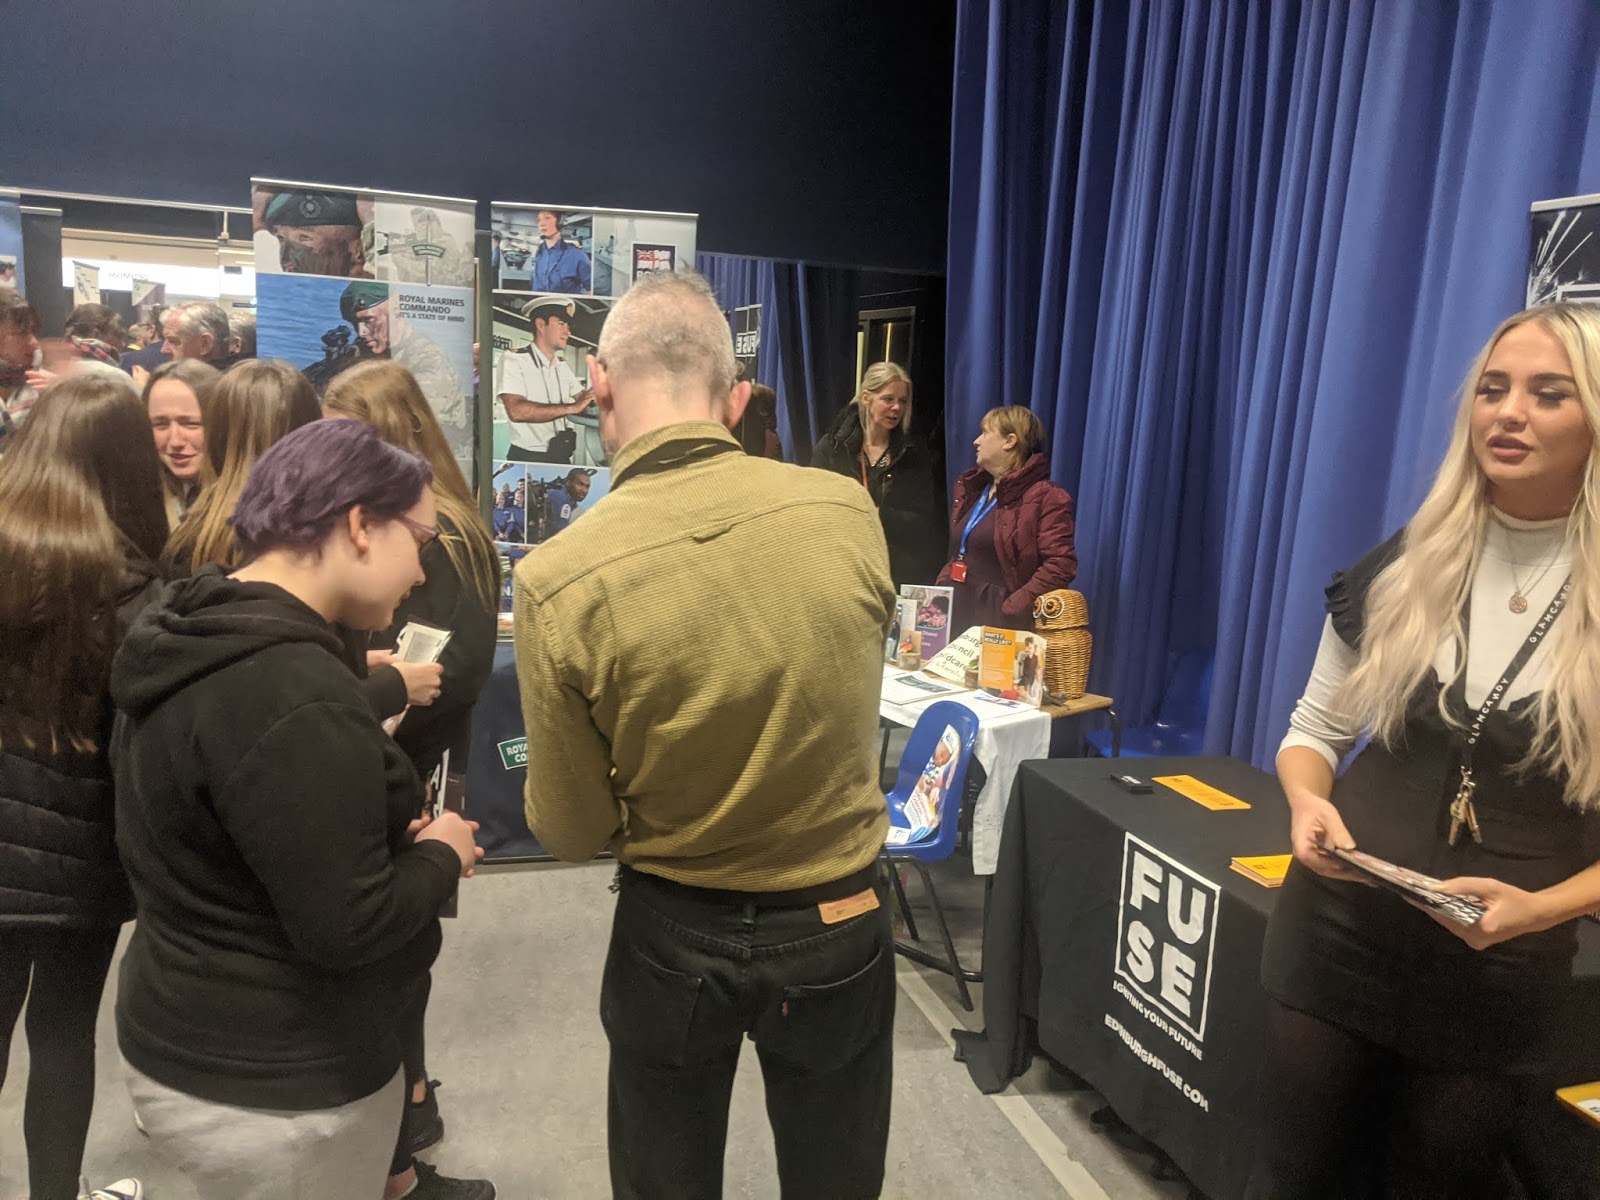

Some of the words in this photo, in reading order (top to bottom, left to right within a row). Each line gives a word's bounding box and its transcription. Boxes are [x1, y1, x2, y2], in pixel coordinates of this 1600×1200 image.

[399, 294, 426, 304] ROYAL
[428, 296, 465, 307] MARINES
[399, 303, 451, 314] COMMANDO
[1529, 584, 1570, 644] GLAMCAND
[1468, 678, 1509, 744] GLAMCANDY
[506, 743, 528, 756] ROYA
[1113, 980, 1144, 1014] IGNITING
[1143, 1007, 1169, 1033] YOUR
[1168, 1026, 1203, 1060] FUTURE
